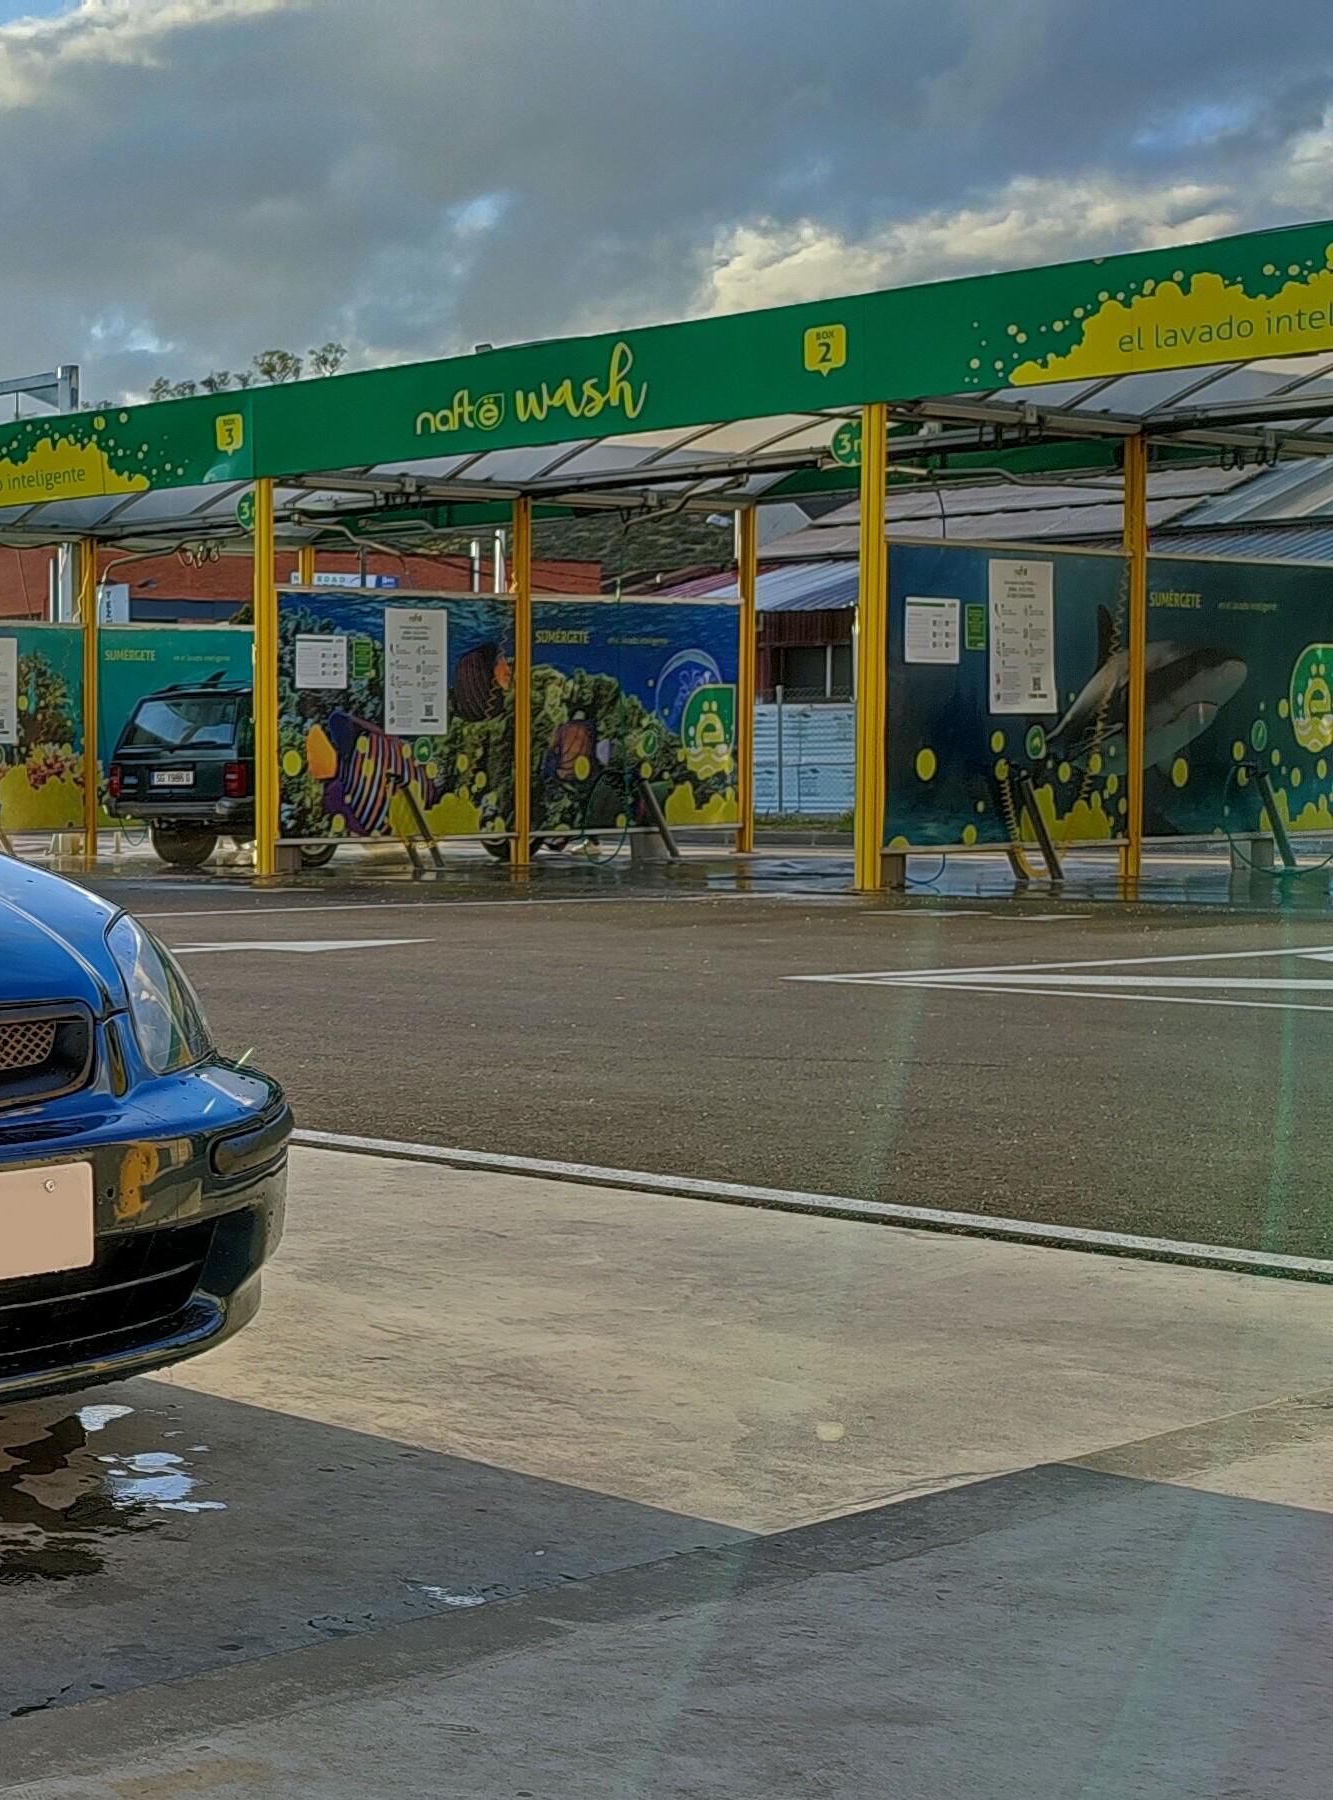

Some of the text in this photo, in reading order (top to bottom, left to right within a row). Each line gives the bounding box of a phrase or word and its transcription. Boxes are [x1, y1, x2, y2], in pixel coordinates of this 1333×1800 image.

[1118, 326, 1144, 352] el
[1155, 314, 1254, 349] lavado
[817, 342, 832, 364] 2
[515, 342, 648, 424] wash
[225, 427, 234, 446] 3
[7, 467, 86, 491] inteligente
